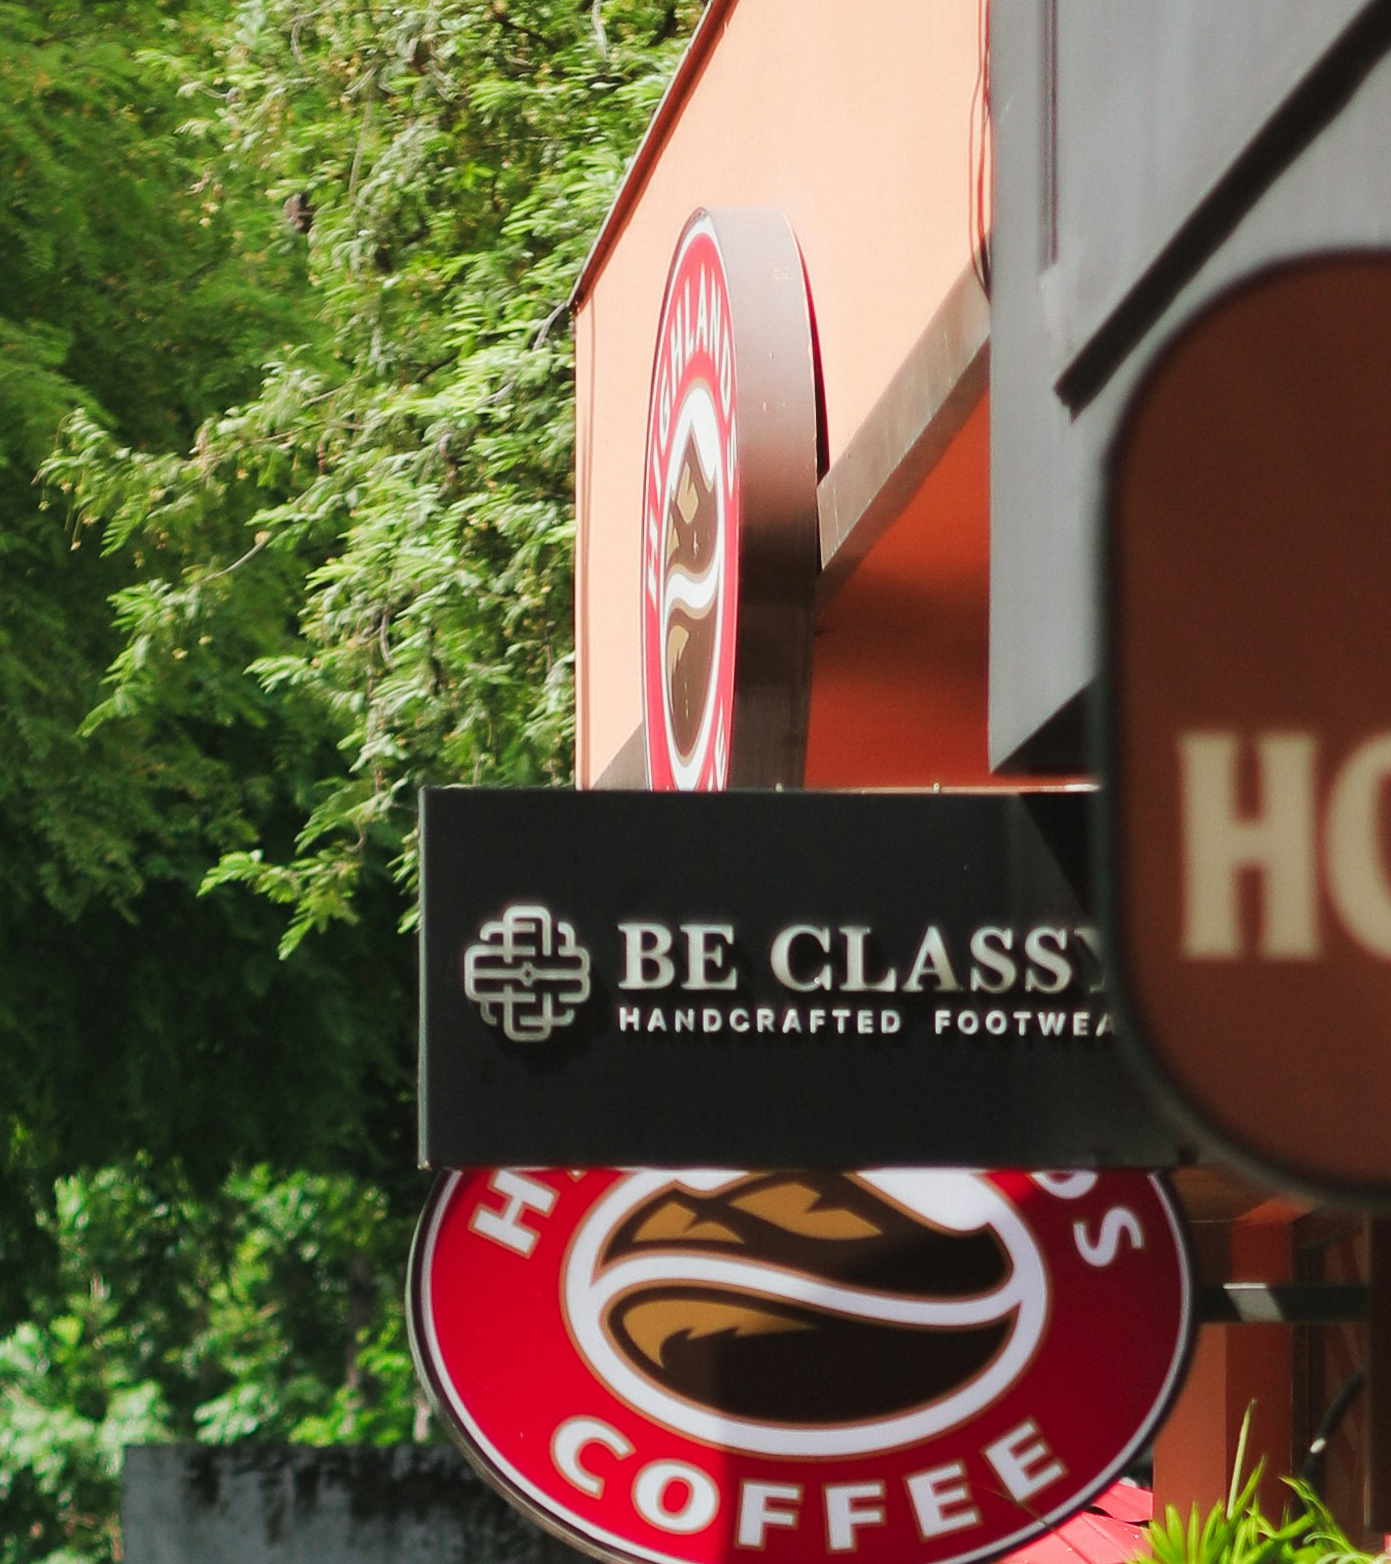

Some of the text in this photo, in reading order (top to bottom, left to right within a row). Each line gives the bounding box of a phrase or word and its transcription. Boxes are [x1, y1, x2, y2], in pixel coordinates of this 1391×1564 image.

[647, 264, 739, 611] HIGHLANDS
[617, 923, 739, 990] BE
[618, 1006, 902, 1035] HANDCRAFTED
[551, 1415, 1066, 1555] COFFEE
